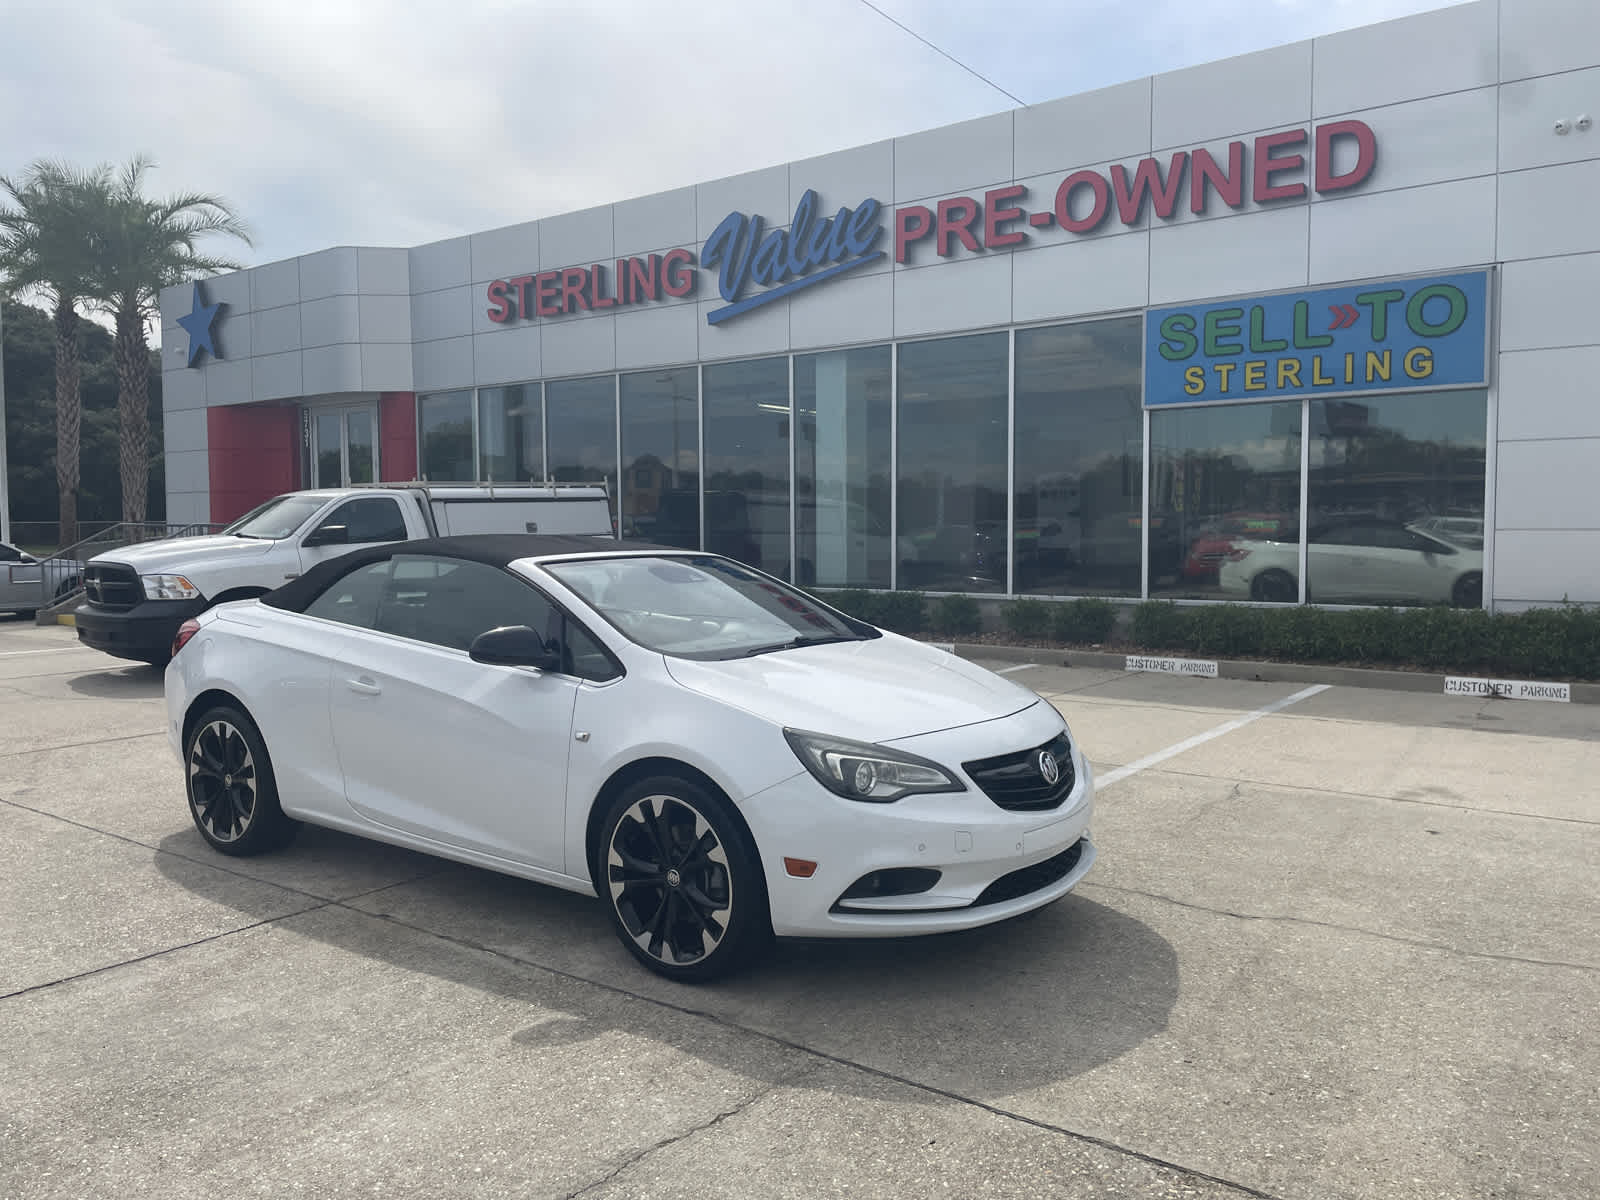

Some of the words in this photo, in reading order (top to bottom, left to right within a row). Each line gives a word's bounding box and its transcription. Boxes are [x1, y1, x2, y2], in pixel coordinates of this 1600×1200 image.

[487, 248, 697, 325] STERLING
[701, 188, 885, 304] Value
[895, 119, 1378, 265] PRE-OWNED
[1158, 299, 1334, 361] SELL
[1355, 283, 1468, 343] TO
[1184, 346, 1435, 396] STERLING
[1180, 662, 1216, 674] PARKING
[1520, 684, 1567, 699] PARKING
